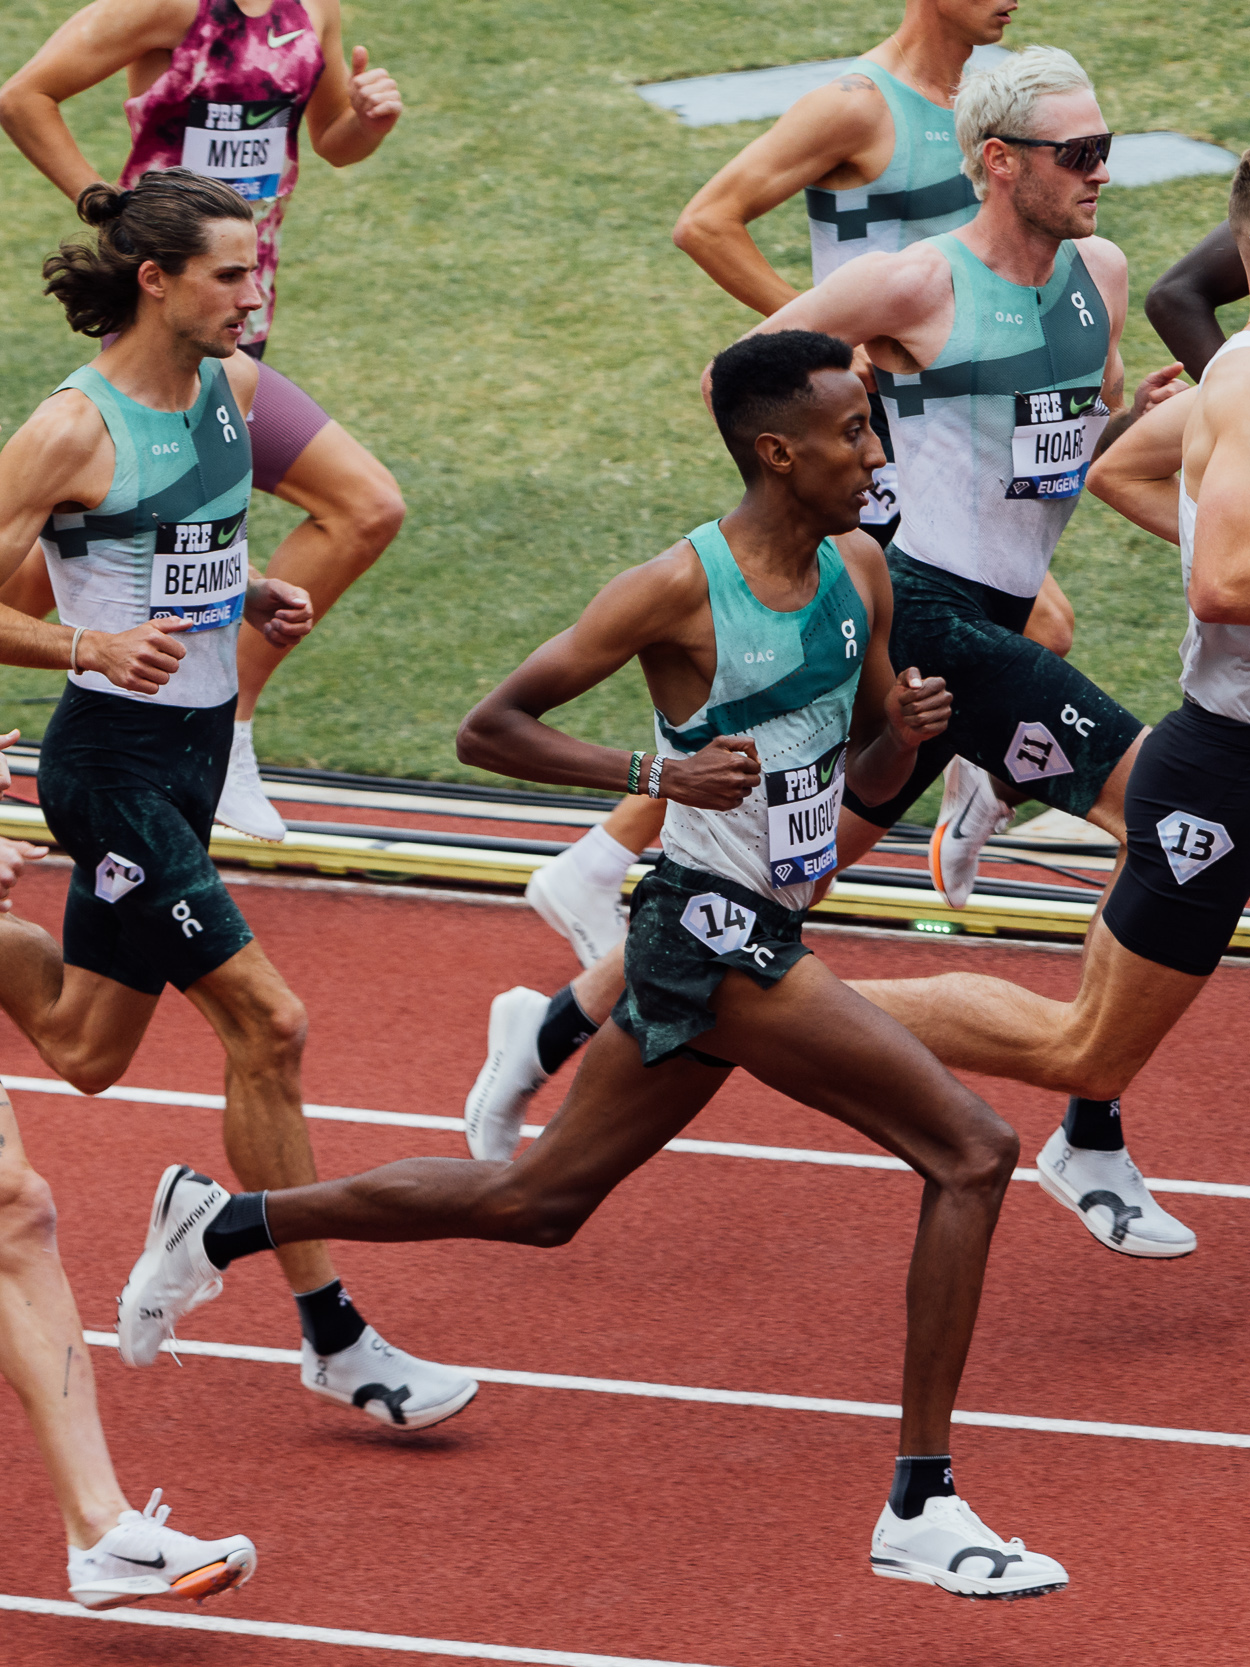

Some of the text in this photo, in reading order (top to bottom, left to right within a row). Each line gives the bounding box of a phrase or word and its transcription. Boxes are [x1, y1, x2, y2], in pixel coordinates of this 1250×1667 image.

[205, 103, 243, 130] PRE
[925, 131, 950, 141] OAC
[207, 138, 270, 168] MYERS
[995, 311, 1023, 325] OAC
[1029, 392, 1063, 423] PRE
[152, 442, 180, 456] OAC
[869, 480, 897, 511] 5
[174, 523, 212, 553] PRE
[164, 552, 242, 595] BEAMISH
[744, 649, 775, 664] OAC
[1016, 735, 1054, 772] 11
[784, 764, 819, 802] PRE
[1170, 821, 1216, 861] 13
[699, 900, 747, 939] 14
[165, 1189, 222, 1253] ON RUNNING
